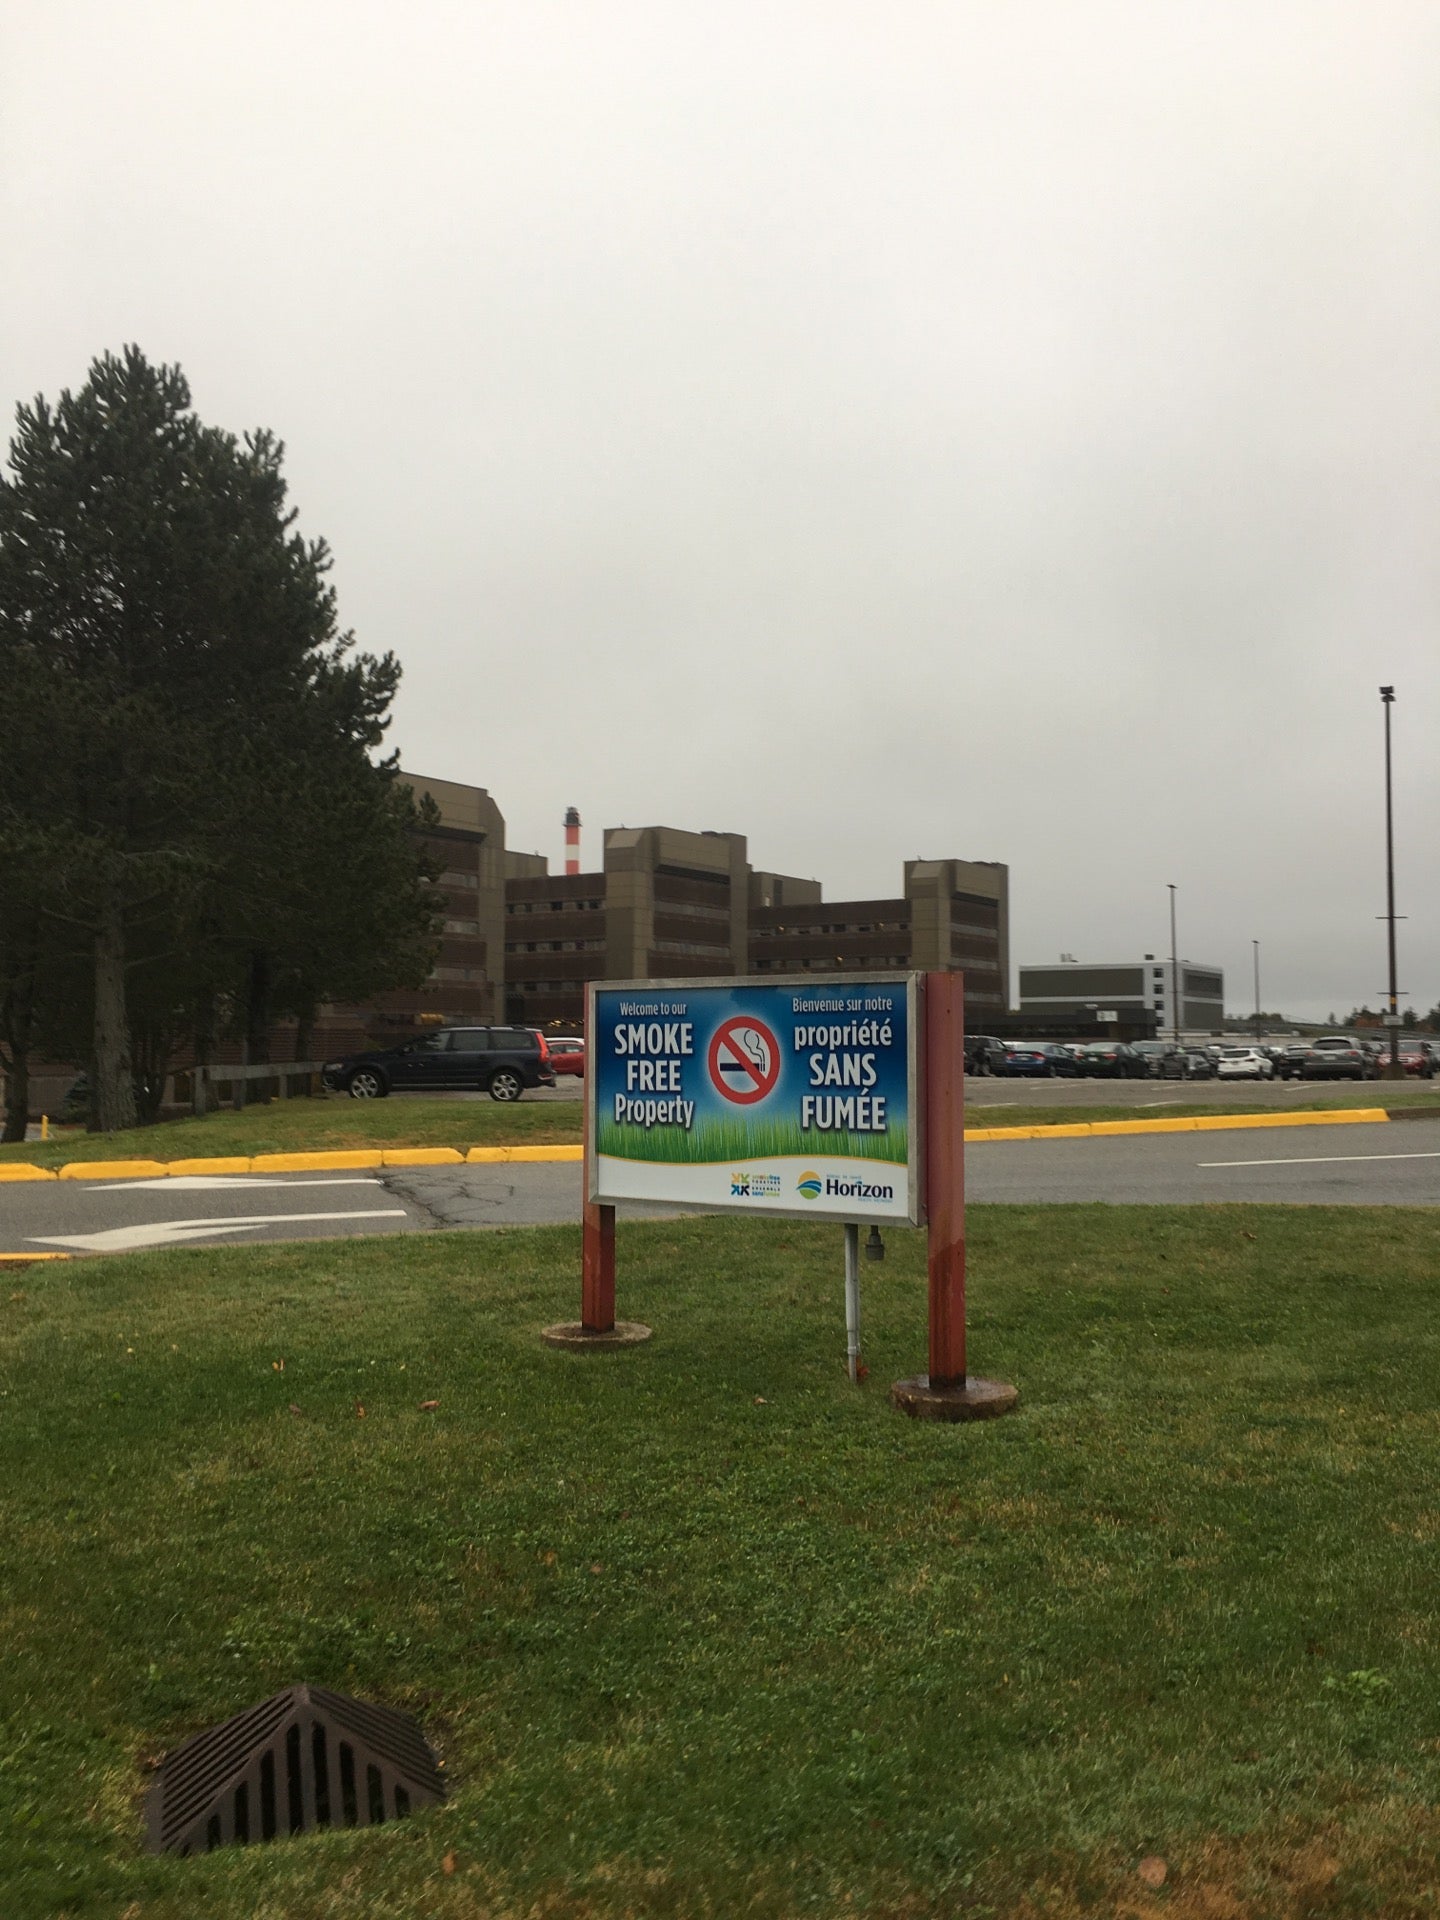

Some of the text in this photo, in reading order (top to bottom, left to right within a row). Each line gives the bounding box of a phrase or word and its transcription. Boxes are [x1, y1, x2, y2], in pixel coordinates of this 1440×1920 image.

[619, 1002, 687, 1016] Welcome to our
[793, 996, 892, 1012] Bienvenue sur notre
[614, 1022, 693, 1055] SMOKE
[794, 1018, 892, 1050] propriété
[626, 1060, 681, 1092] FREE
[809, 1053, 876, 1087] SANS
[614, 1093, 694, 1128] Property
[801, 1088, 886, 1130] FUMÉE
[826, 1178, 893, 1199] Horizon
